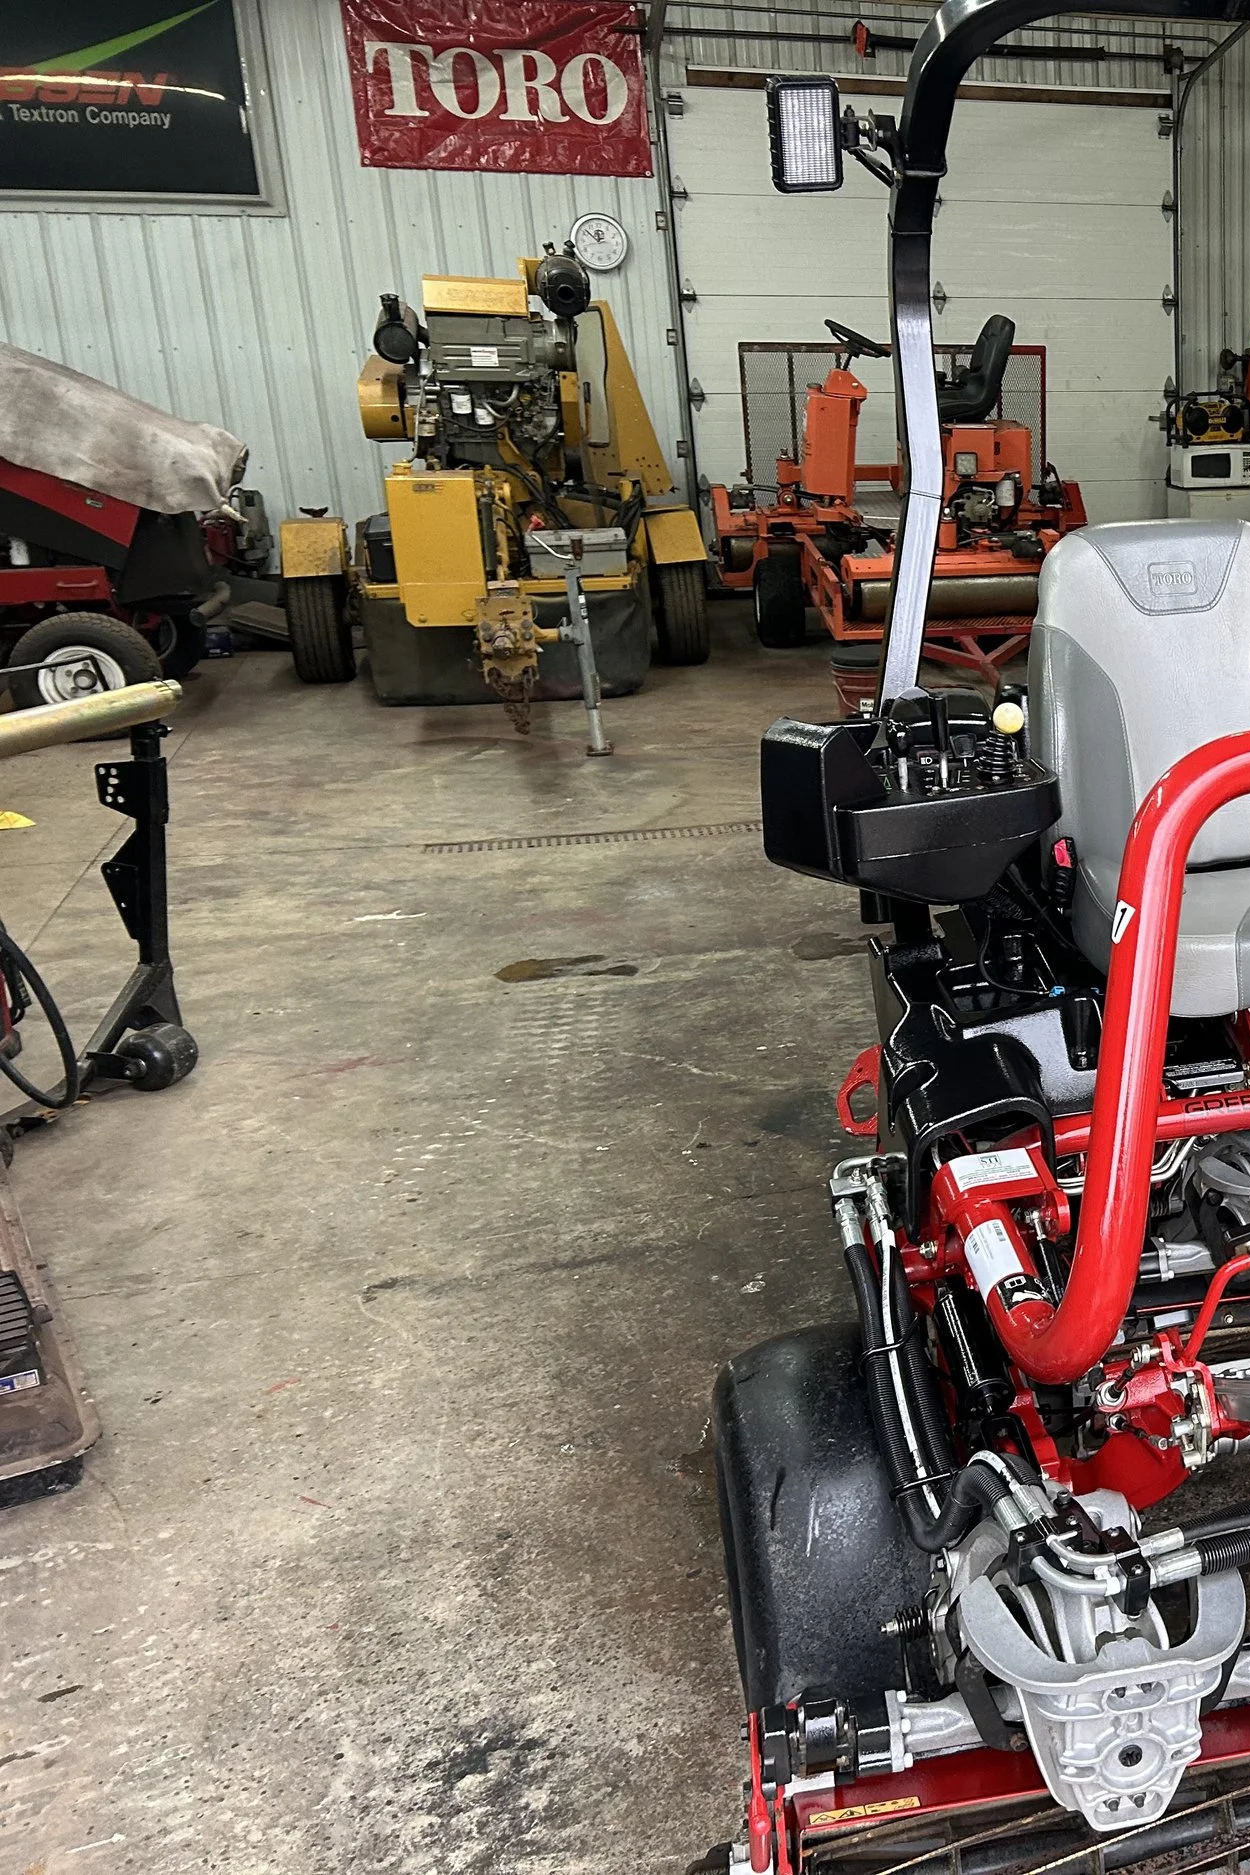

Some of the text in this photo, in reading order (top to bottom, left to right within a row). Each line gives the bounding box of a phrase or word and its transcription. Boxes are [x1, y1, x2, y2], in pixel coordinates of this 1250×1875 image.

[364, 40, 628, 125] TORO
[8, 104, 79, 123] Textron
[86, 106, 171, 128] Company
[1152, 572, 1192, 586] TORO
